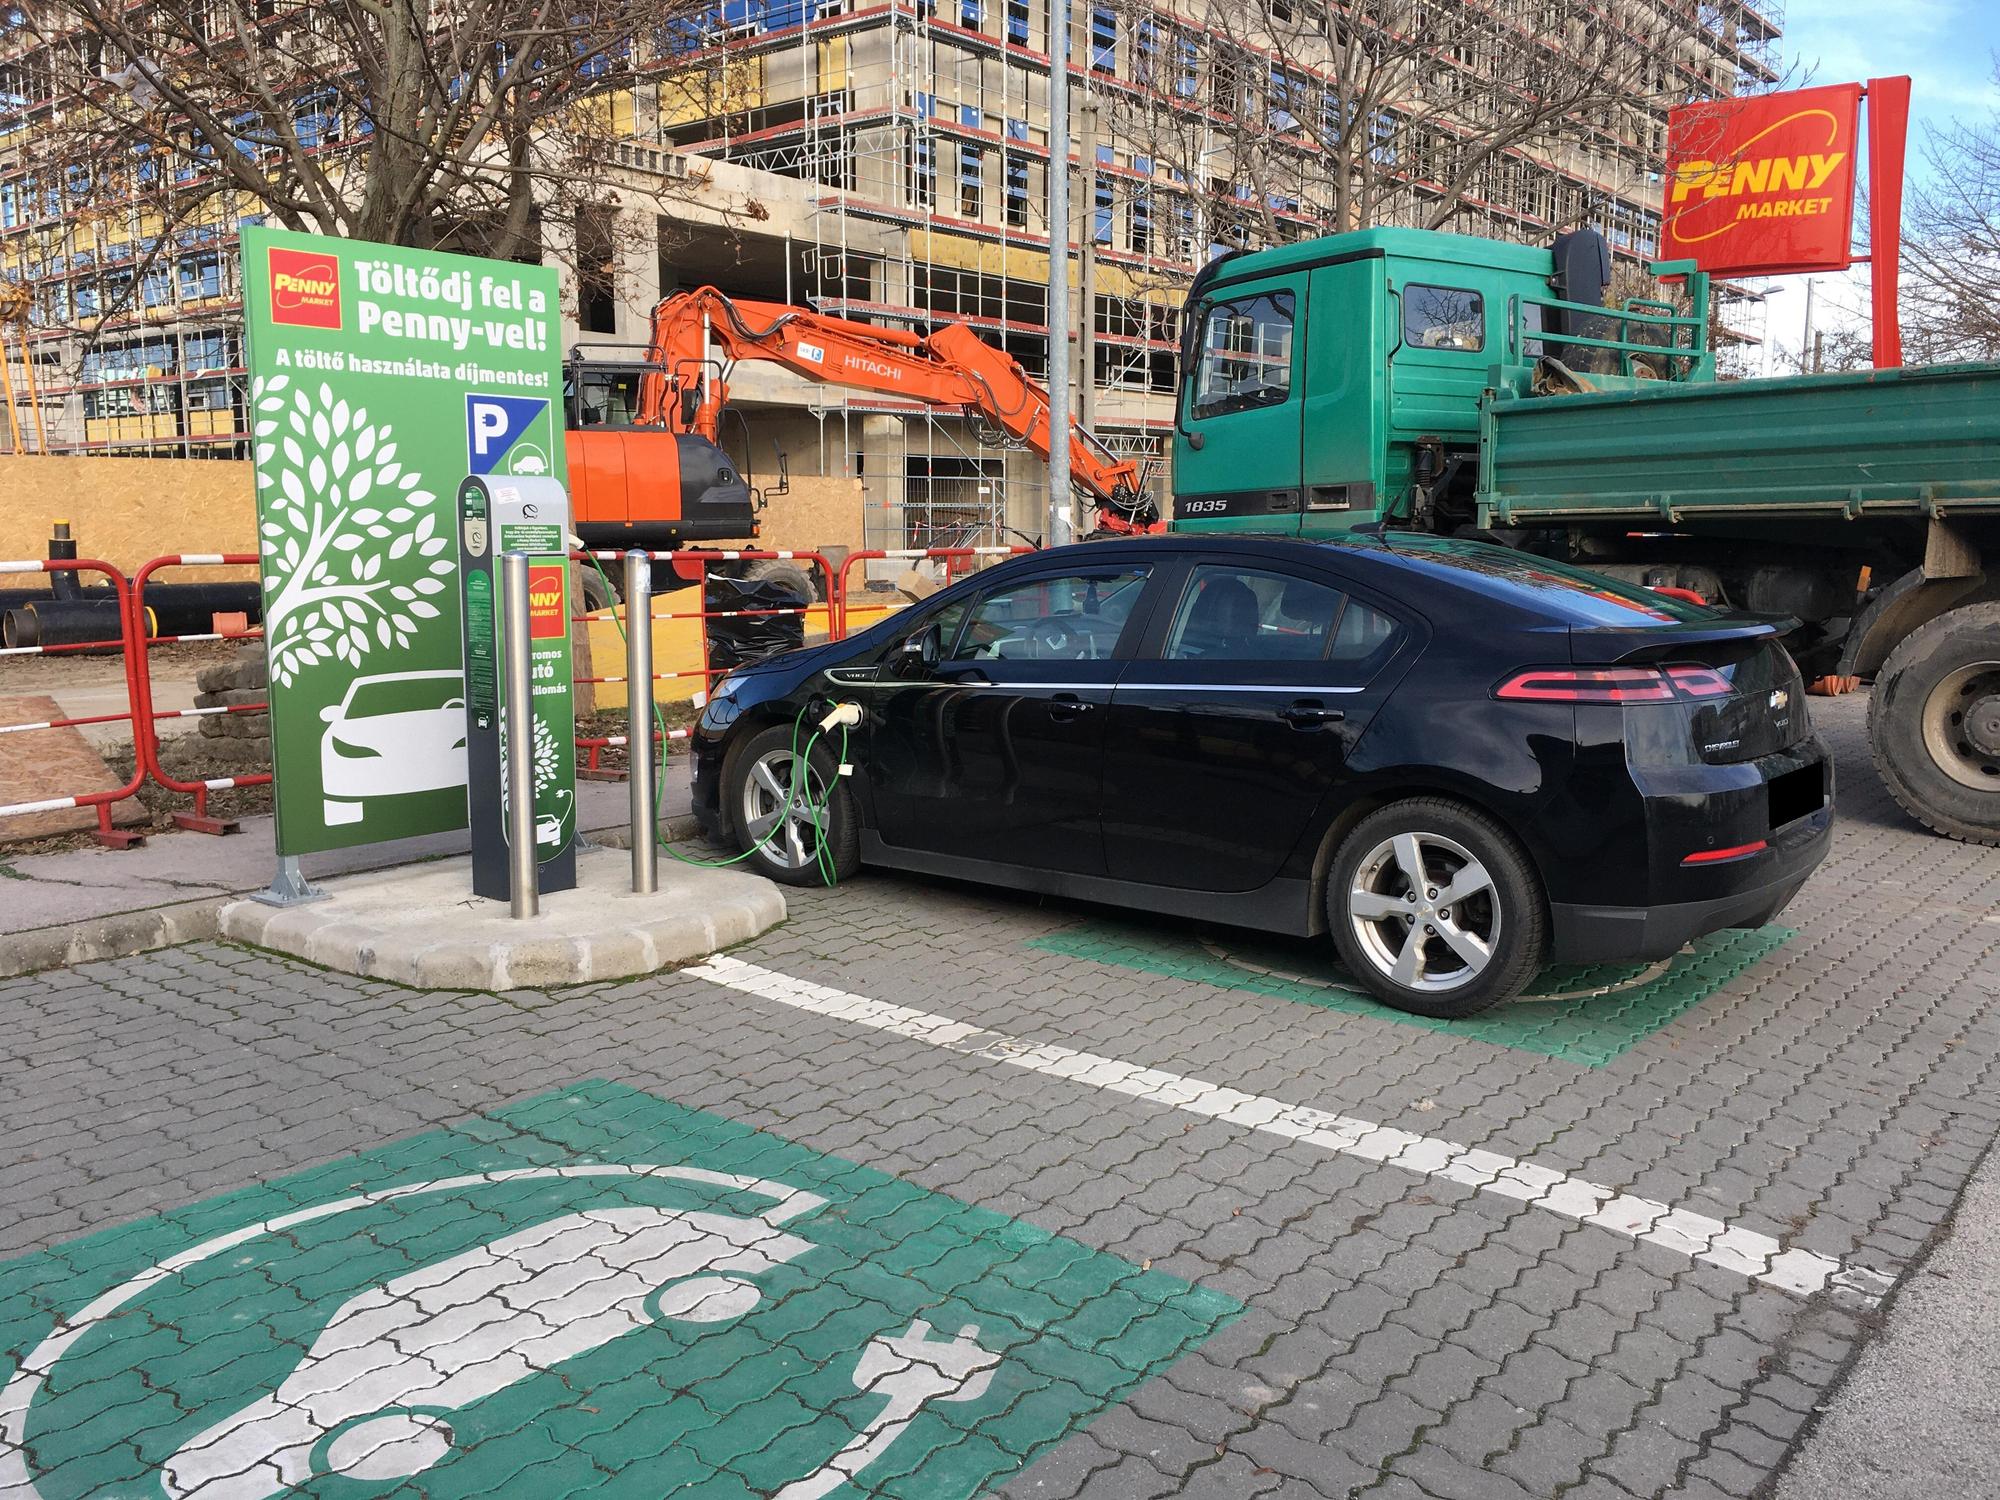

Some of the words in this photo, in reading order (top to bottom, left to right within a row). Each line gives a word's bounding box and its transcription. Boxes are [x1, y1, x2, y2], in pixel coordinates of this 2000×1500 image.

[1671, 152, 1847, 202] PENNY
[1735, 197, 1833, 220] MARKET
[274, 272, 337, 297] PENNY
[353, 260, 473, 311] Töltődj
[479, 275, 523, 311] fel
[528, 289, 546, 314] a
[301, 296, 334, 307] MARKET
[357, 300, 547, 351] Penny-vel!
[275, 348, 292, 367] A
[294, 348, 345, 371] töltő
[348, 352, 451, 380] használata
[454, 361, 549, 388] díjmentes!
[843, 354, 903, 381] HITACHI
[473, 403, 509, 454] P
[1185, 500, 1227, 513] 1835
[529, 591, 562, 607] NNY
